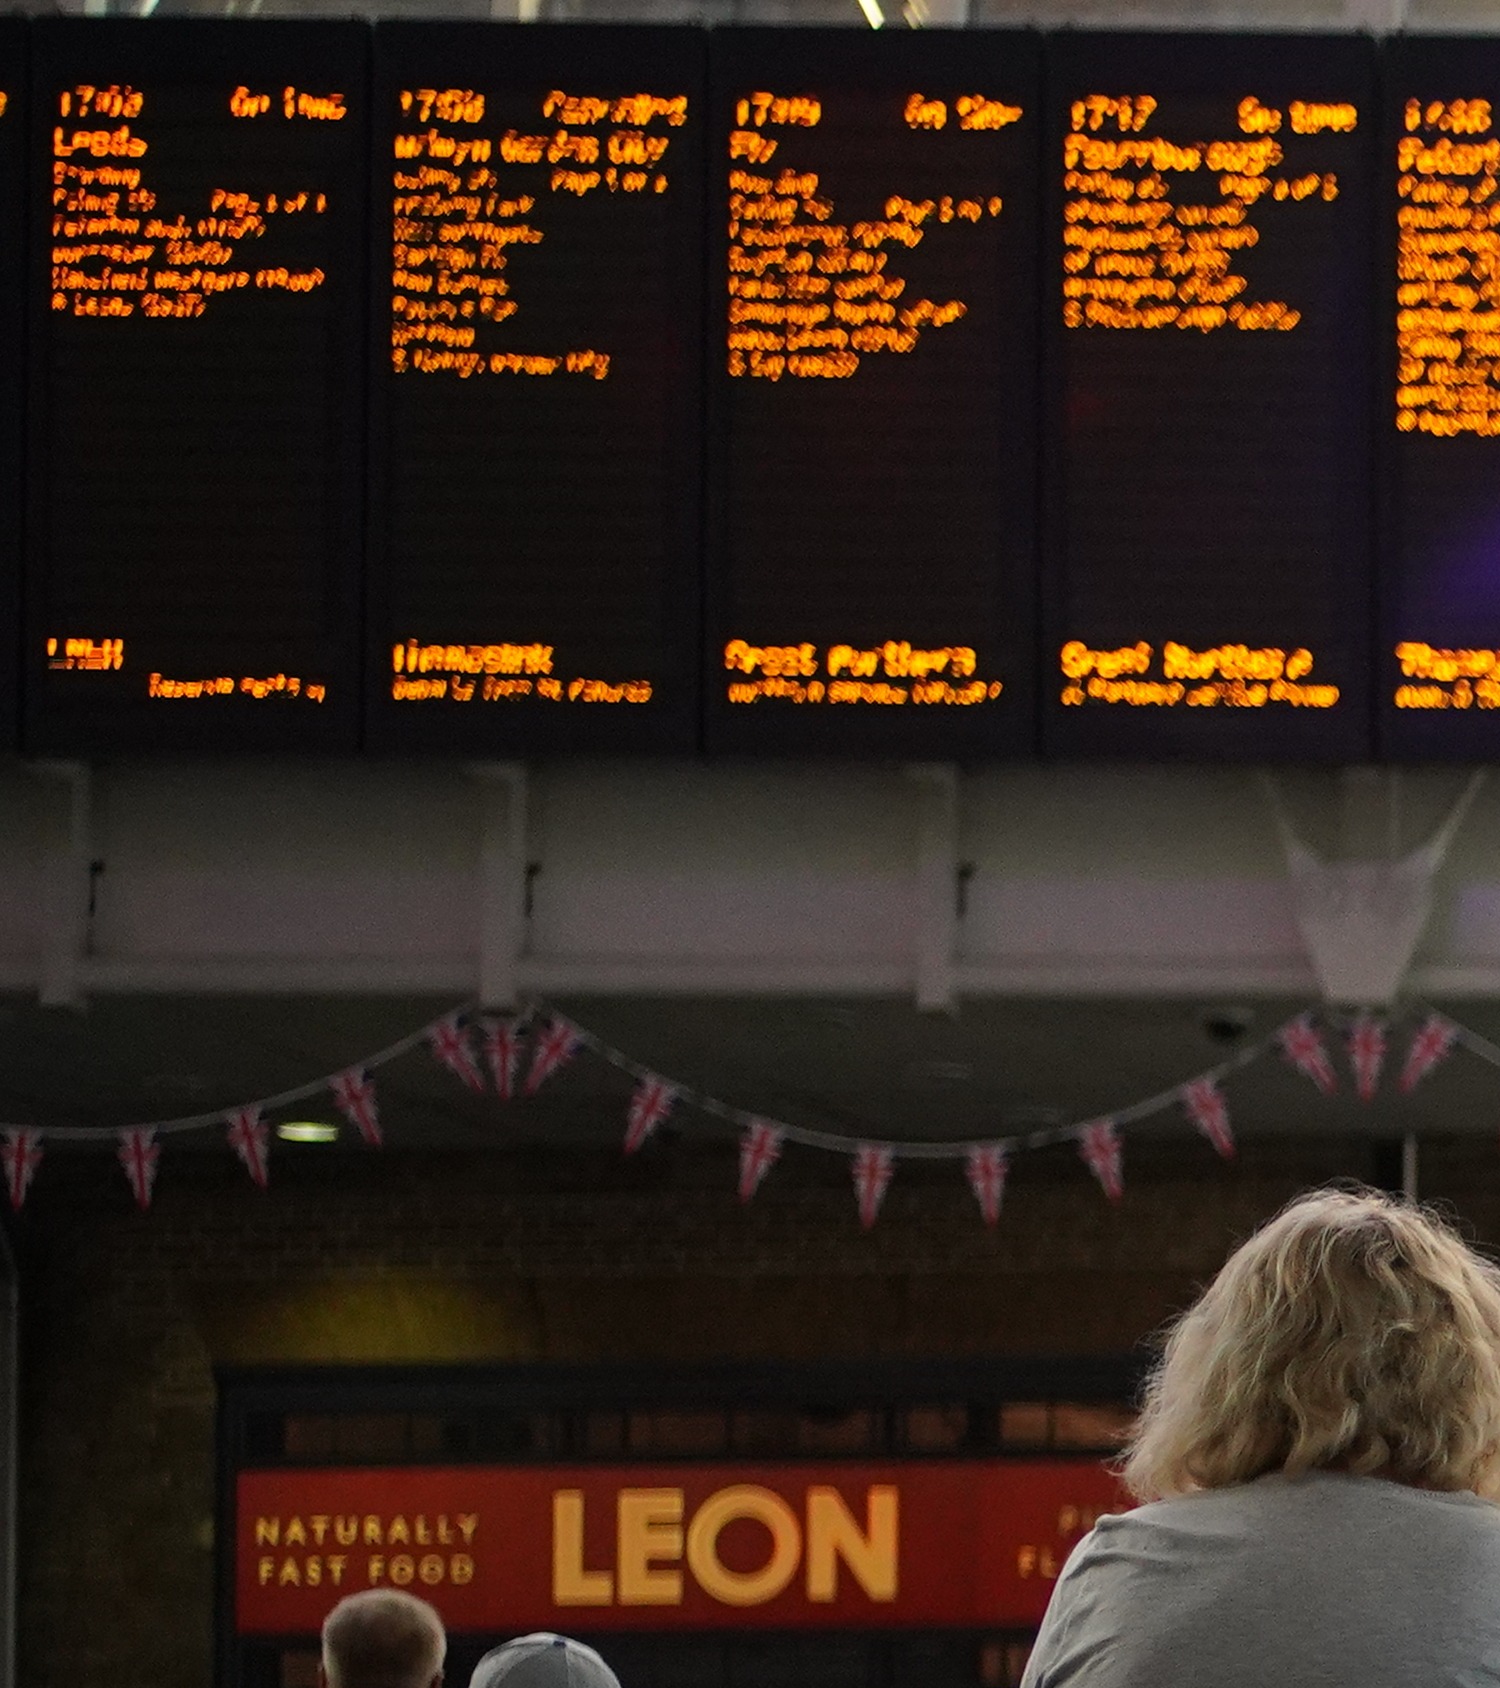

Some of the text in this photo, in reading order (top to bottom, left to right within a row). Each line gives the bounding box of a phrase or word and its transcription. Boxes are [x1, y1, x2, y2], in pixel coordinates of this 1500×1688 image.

[255, 1512, 479, 1547] NATURALLY
[553, 1483, 898, 1607] LEON
[258, 1553, 475, 1586] FAST FOOD
